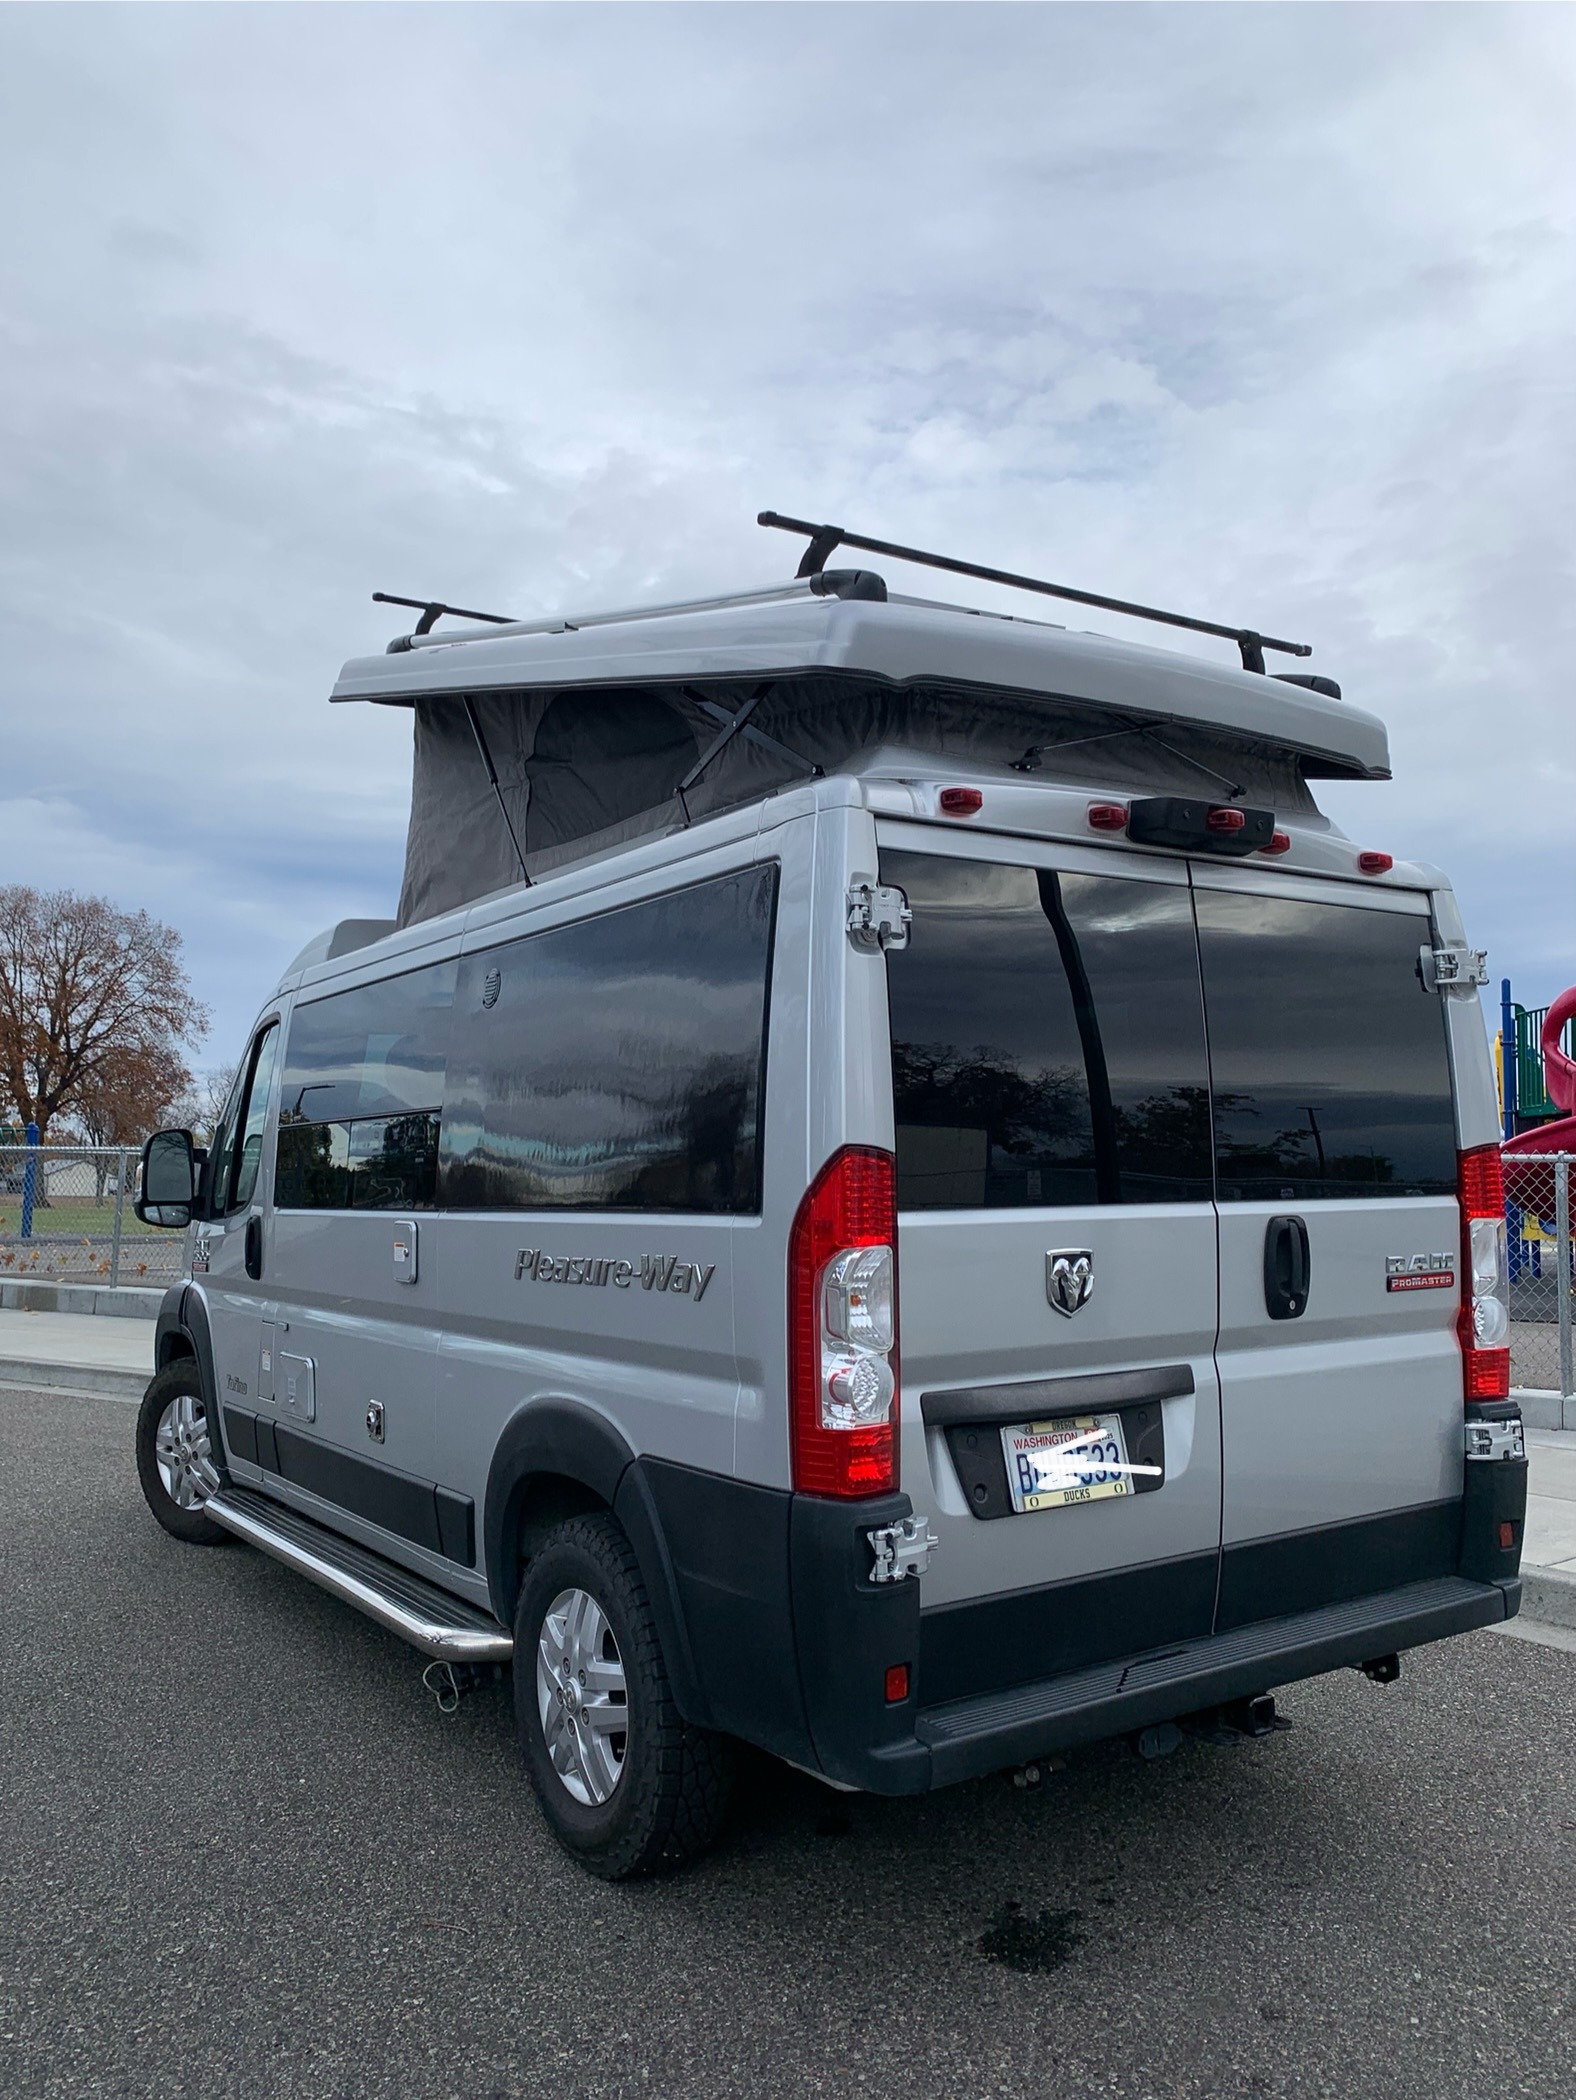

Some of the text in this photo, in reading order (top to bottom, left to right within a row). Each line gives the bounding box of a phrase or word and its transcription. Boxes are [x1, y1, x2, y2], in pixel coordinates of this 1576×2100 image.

[1386, 1252, 1454, 1273] RAM
[514, 1248, 716, 1301] Pleasure-Way
[1052, 1418, 1076, 1430] OREGON
[1013, 1432, 1078, 1450] WASHINGTON
[1063, 1488, 1091, 1502] DUCKS
